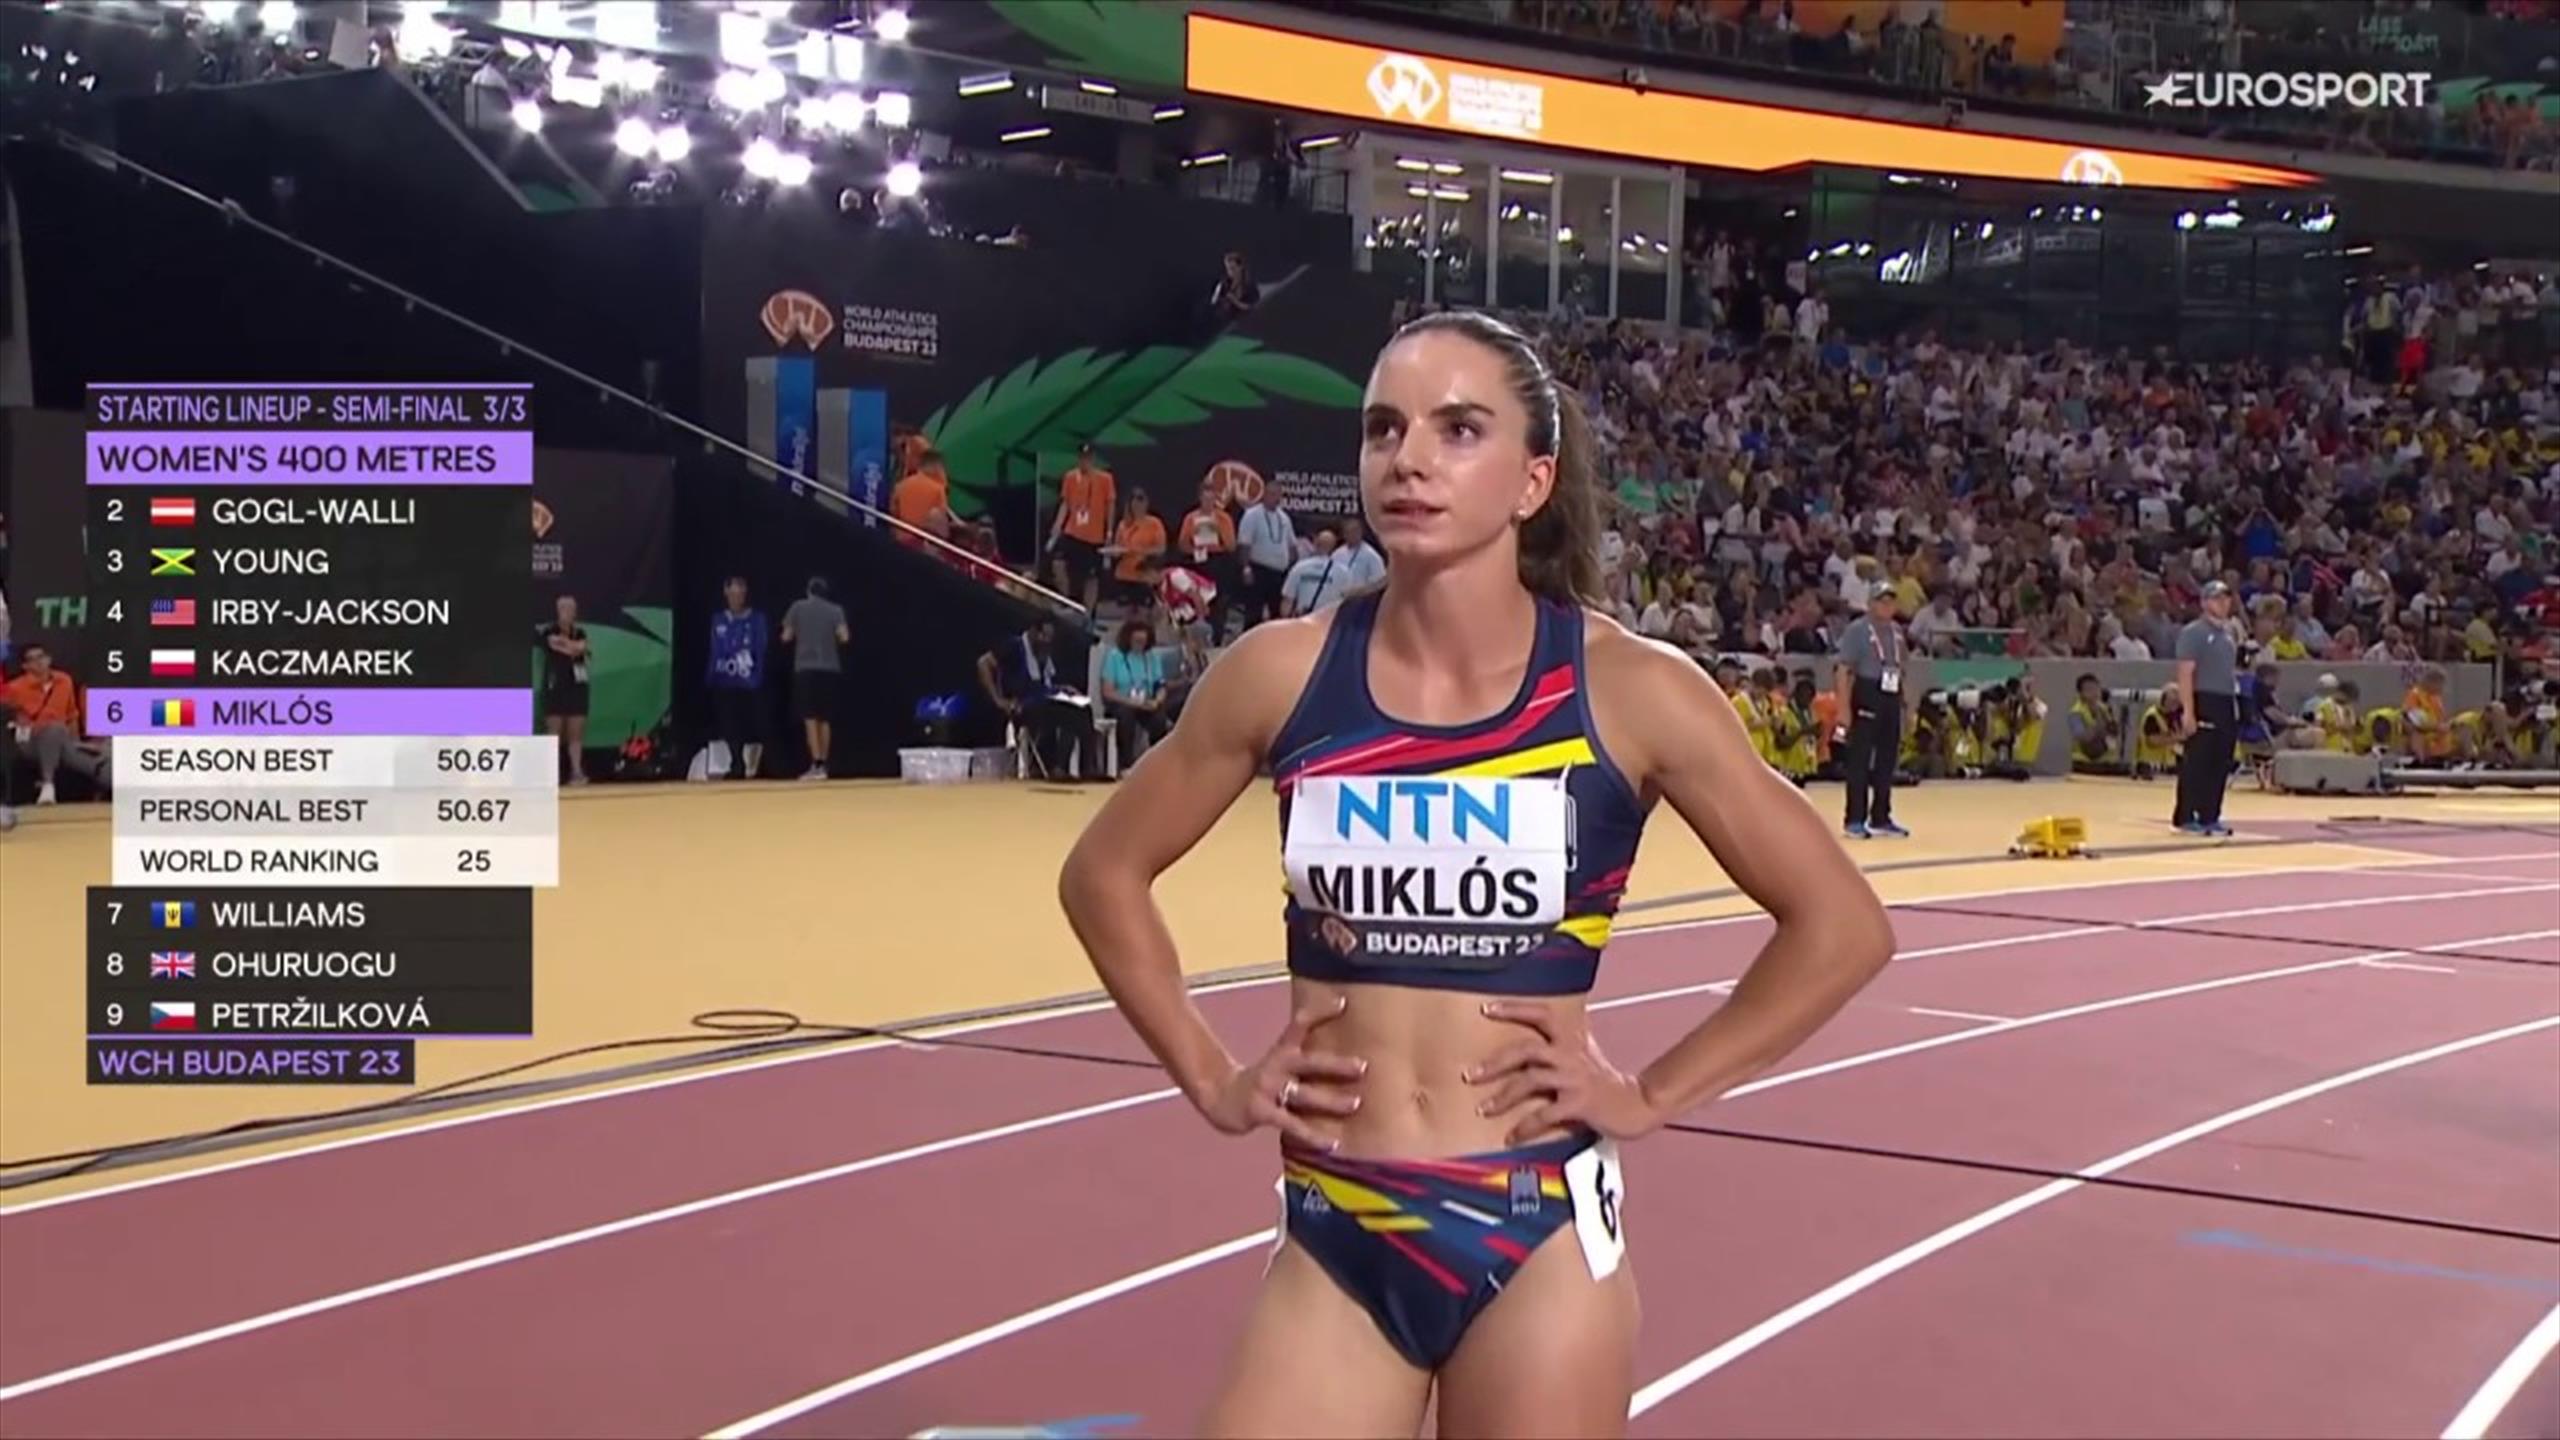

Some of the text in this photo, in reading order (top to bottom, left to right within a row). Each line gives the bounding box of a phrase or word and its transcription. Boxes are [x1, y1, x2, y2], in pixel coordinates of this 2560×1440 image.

[844, 306, 938, 325] WORLD ATHLETICS
[843, 319, 938, 340] CHAMPIONSHIPS
[844, 333, 938, 356] BUDAPEST 23
[1337, 781, 1510, 844] NTN
[1308, 856, 1539, 918] MIKLÓS
[1365, 931, 1511, 957] BUDAPEST
[1595, 1159, 1617, 1243] 6
